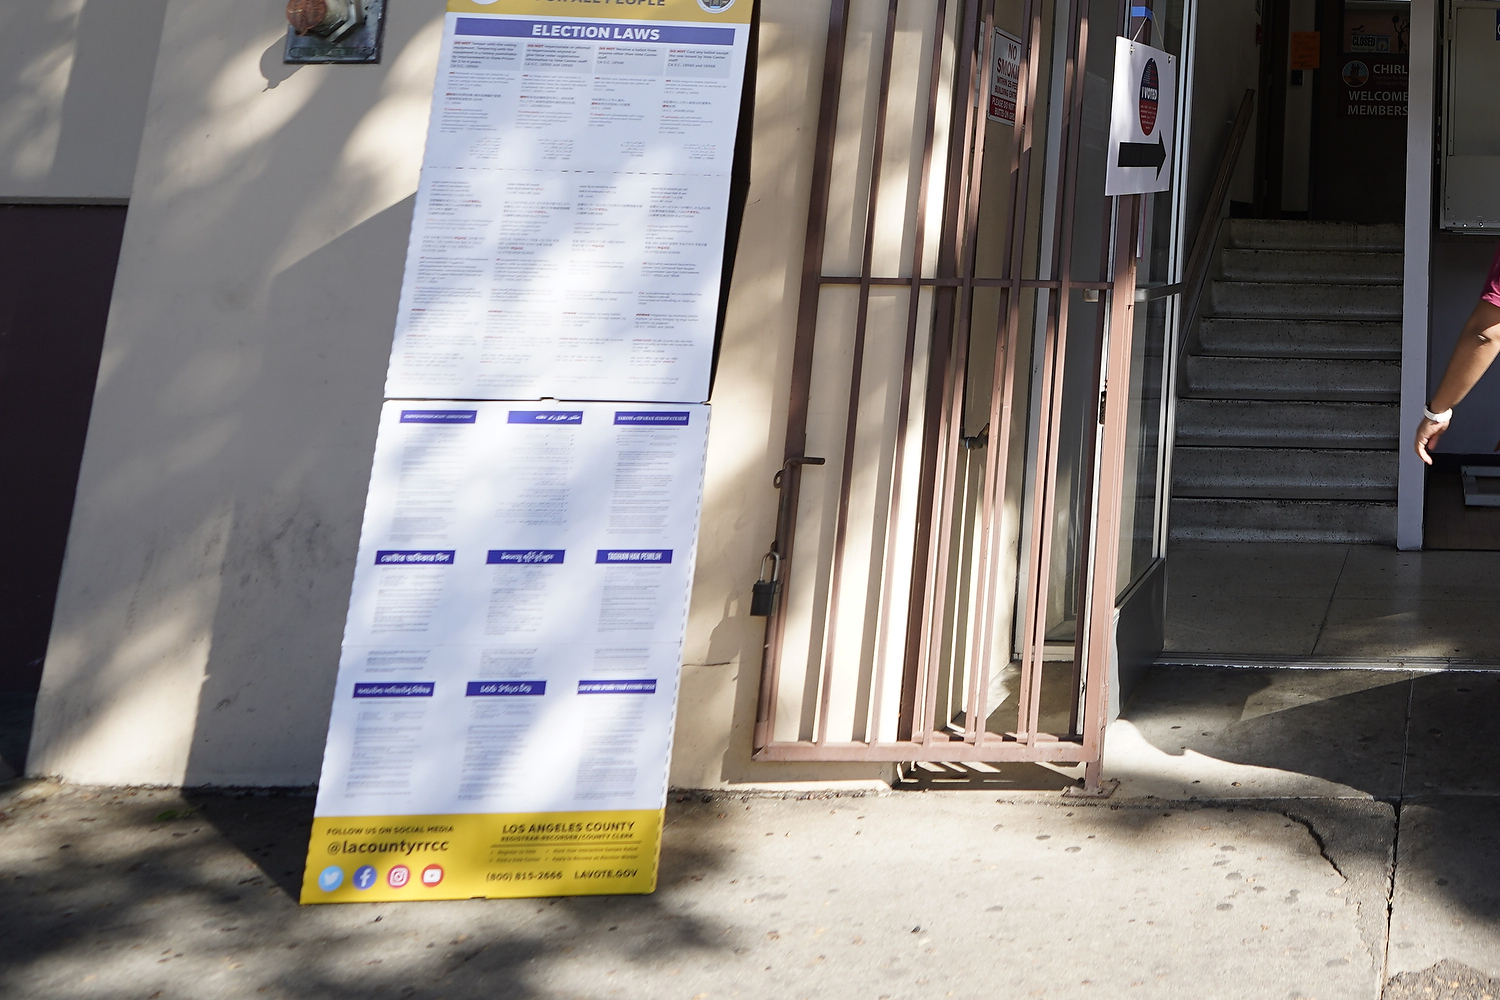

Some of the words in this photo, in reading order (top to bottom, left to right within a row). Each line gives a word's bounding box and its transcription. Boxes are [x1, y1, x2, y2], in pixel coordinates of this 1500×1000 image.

[532, 24, 611, 39] ELECTION
[613, 28, 661, 41] LAWS
[1352, 36, 1376, 47] CLOSED
[1007, 43, 1018, 61] NO
[996, 57, 1020, 80] SMOKI
[1373, 64, 1408, 74] CHIRL
[1141, 86, 1145, 98] I
[1144, 87, 1158, 101] VOTED
[1348, 90, 1409, 102] WELCOME
[1347, 104, 1409, 116] MEMBERS
[326, 827, 363, 836] FOLLOW
[364, 827, 377, 835] US
[377, 826, 392, 835] ON
[393, 826, 425, 834] SOCIAL
[425, 825, 455, 834] MEDIA
[501, 823, 526, 834] LOS
[528, 822, 583, 834] ANGELES
[585, 821, 636, 832] COUNTY
[327, 840, 450, 857] @lacountyrrcc
[486, 871, 514, 883] (800)
[514, 870, 563, 881] 815-2666
[573, 869, 639, 880] LAVOTE.GOV
